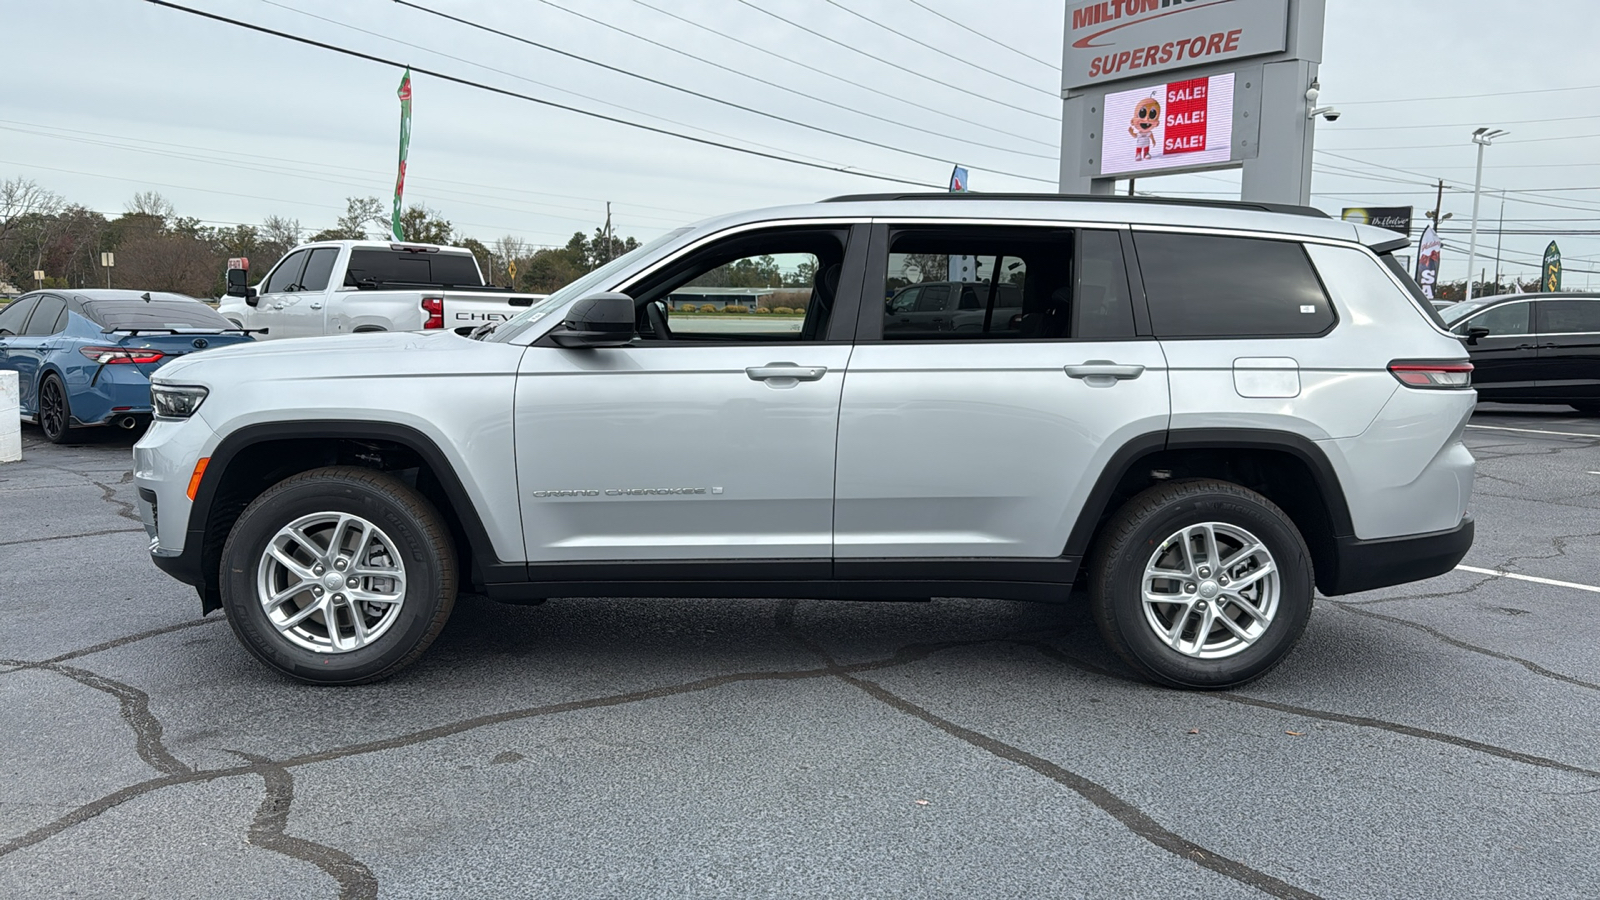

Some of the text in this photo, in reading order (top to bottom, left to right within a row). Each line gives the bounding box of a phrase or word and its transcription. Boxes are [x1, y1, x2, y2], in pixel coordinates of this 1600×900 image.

[1089, 28, 1242, 78] SUPERSTORE
[1168, 86, 1206, 103] SALE!
[1166, 110, 1204, 127] SALE!
[1165, 135, 1203, 151] SALE!
[533, 489, 599, 498] GRAND
[604, 487, 707, 497] CHEROKEE
